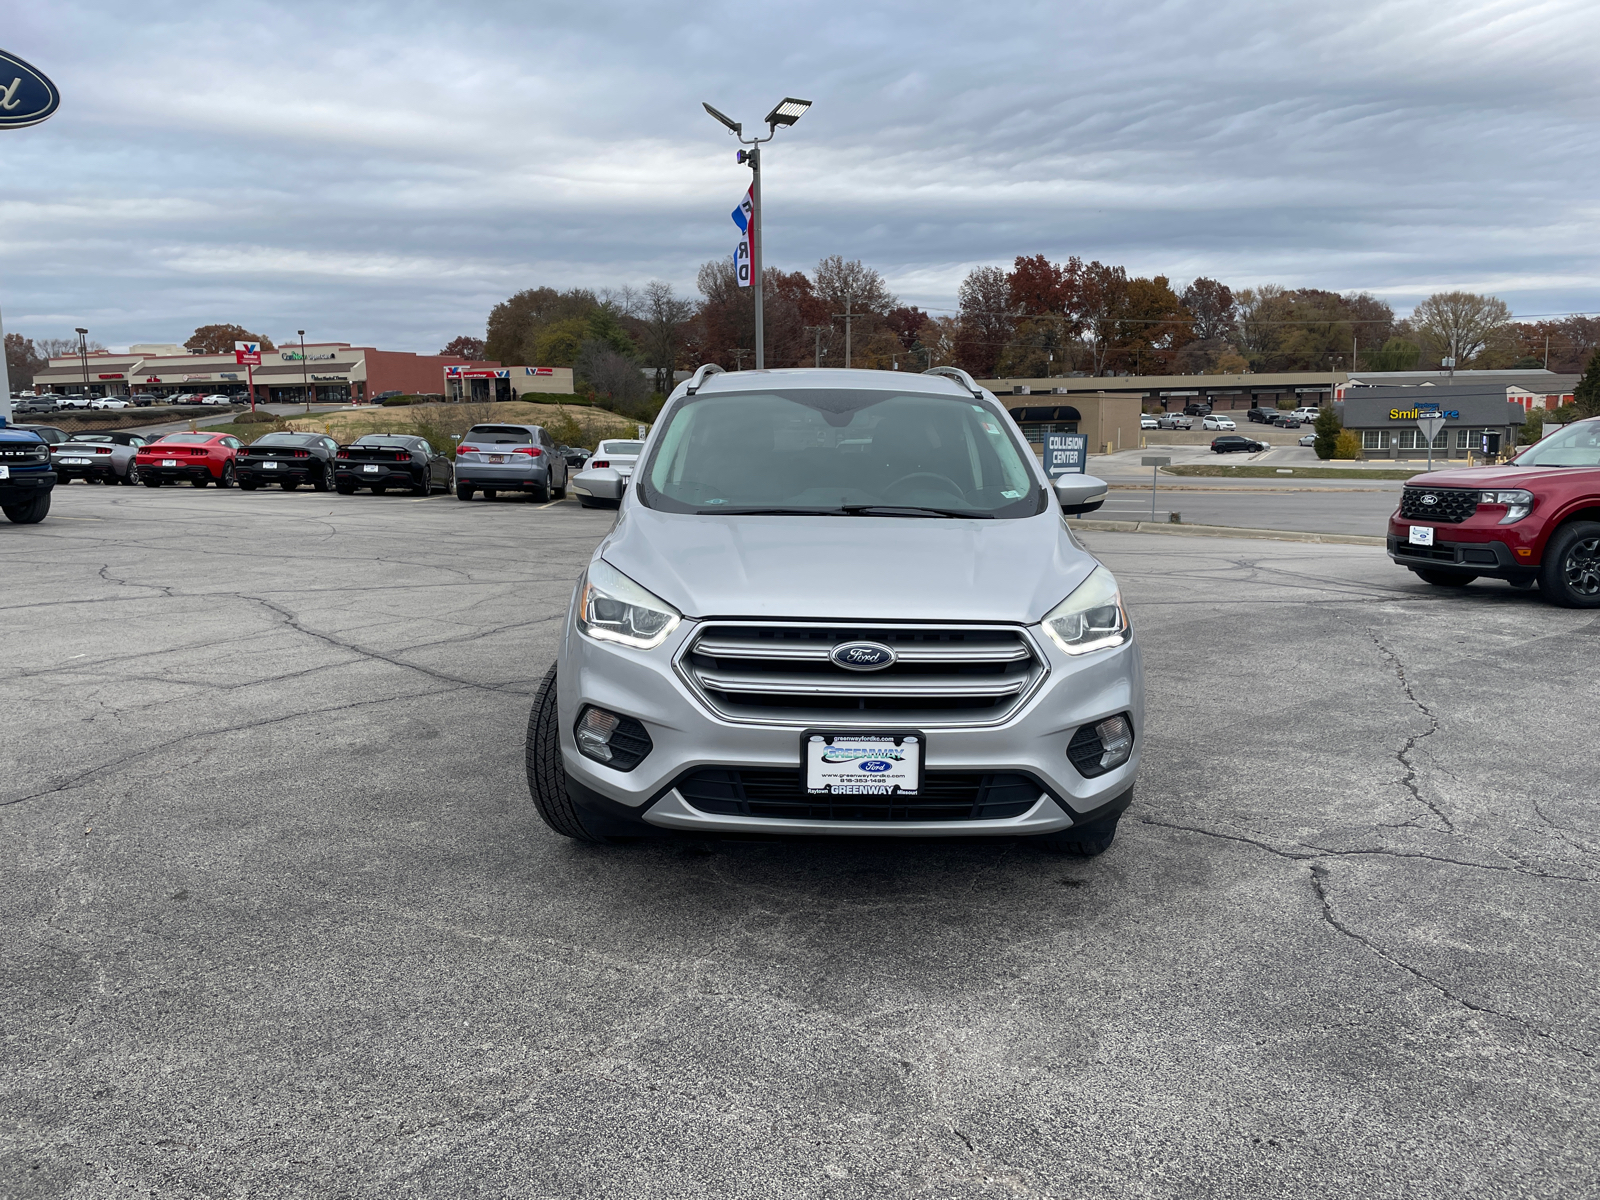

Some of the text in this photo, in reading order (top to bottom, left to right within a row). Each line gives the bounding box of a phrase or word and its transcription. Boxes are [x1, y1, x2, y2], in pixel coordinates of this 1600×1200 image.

[1389, 408, 1425, 419] Smil
[1049, 436, 1083, 450] COLLISION
[1053, 451, 1078, 464] CENTER
[846, 648, 880, 663] Ford
[822, 745, 905, 759] GREENWAY
[865, 762, 885, 771] Ford
[830, 785, 894, 795] GREENWAY
